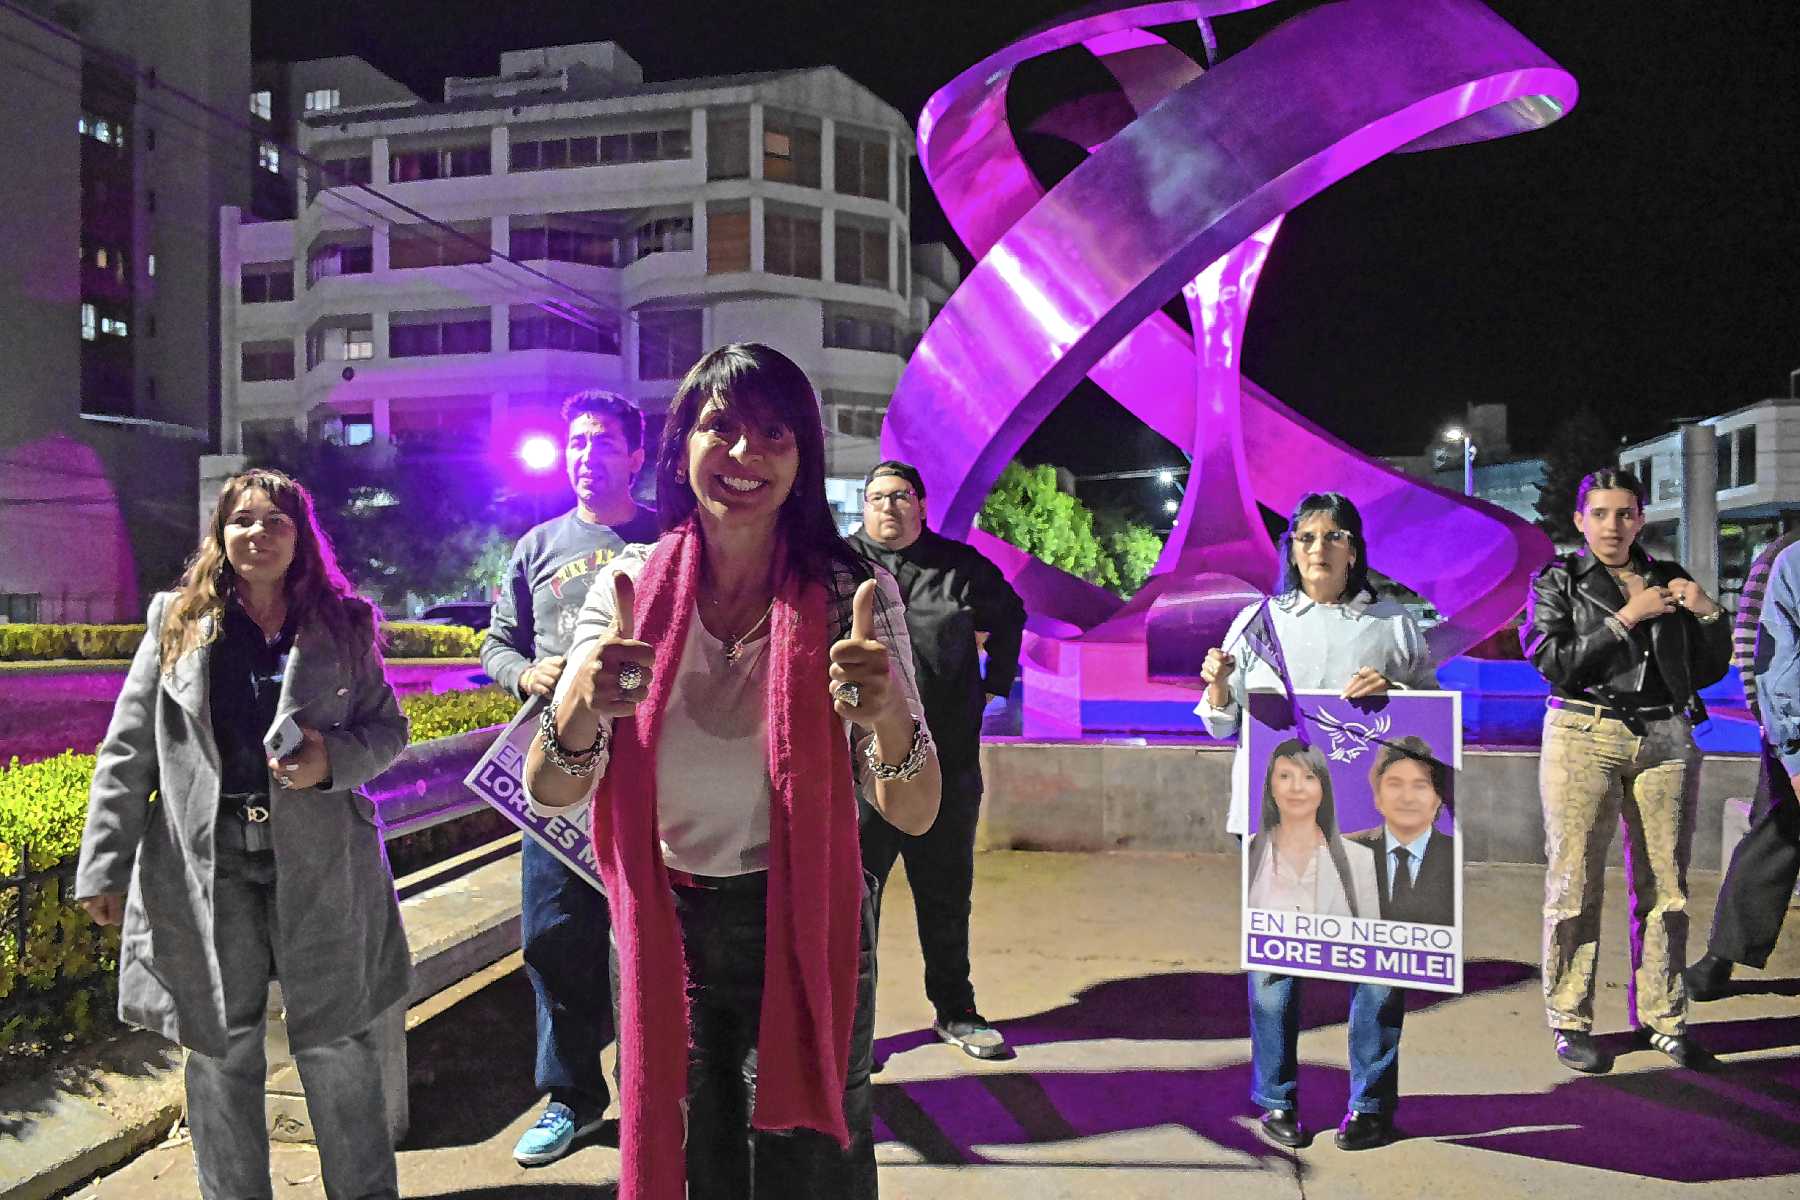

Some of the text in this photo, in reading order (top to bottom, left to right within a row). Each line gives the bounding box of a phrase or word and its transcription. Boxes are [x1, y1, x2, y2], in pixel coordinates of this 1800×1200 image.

[544, 816, 579, 849] ES
[1251, 911, 1453, 950] EN RIO NEGRO
[1250, 937, 1453, 979] LORE ES MILEI
